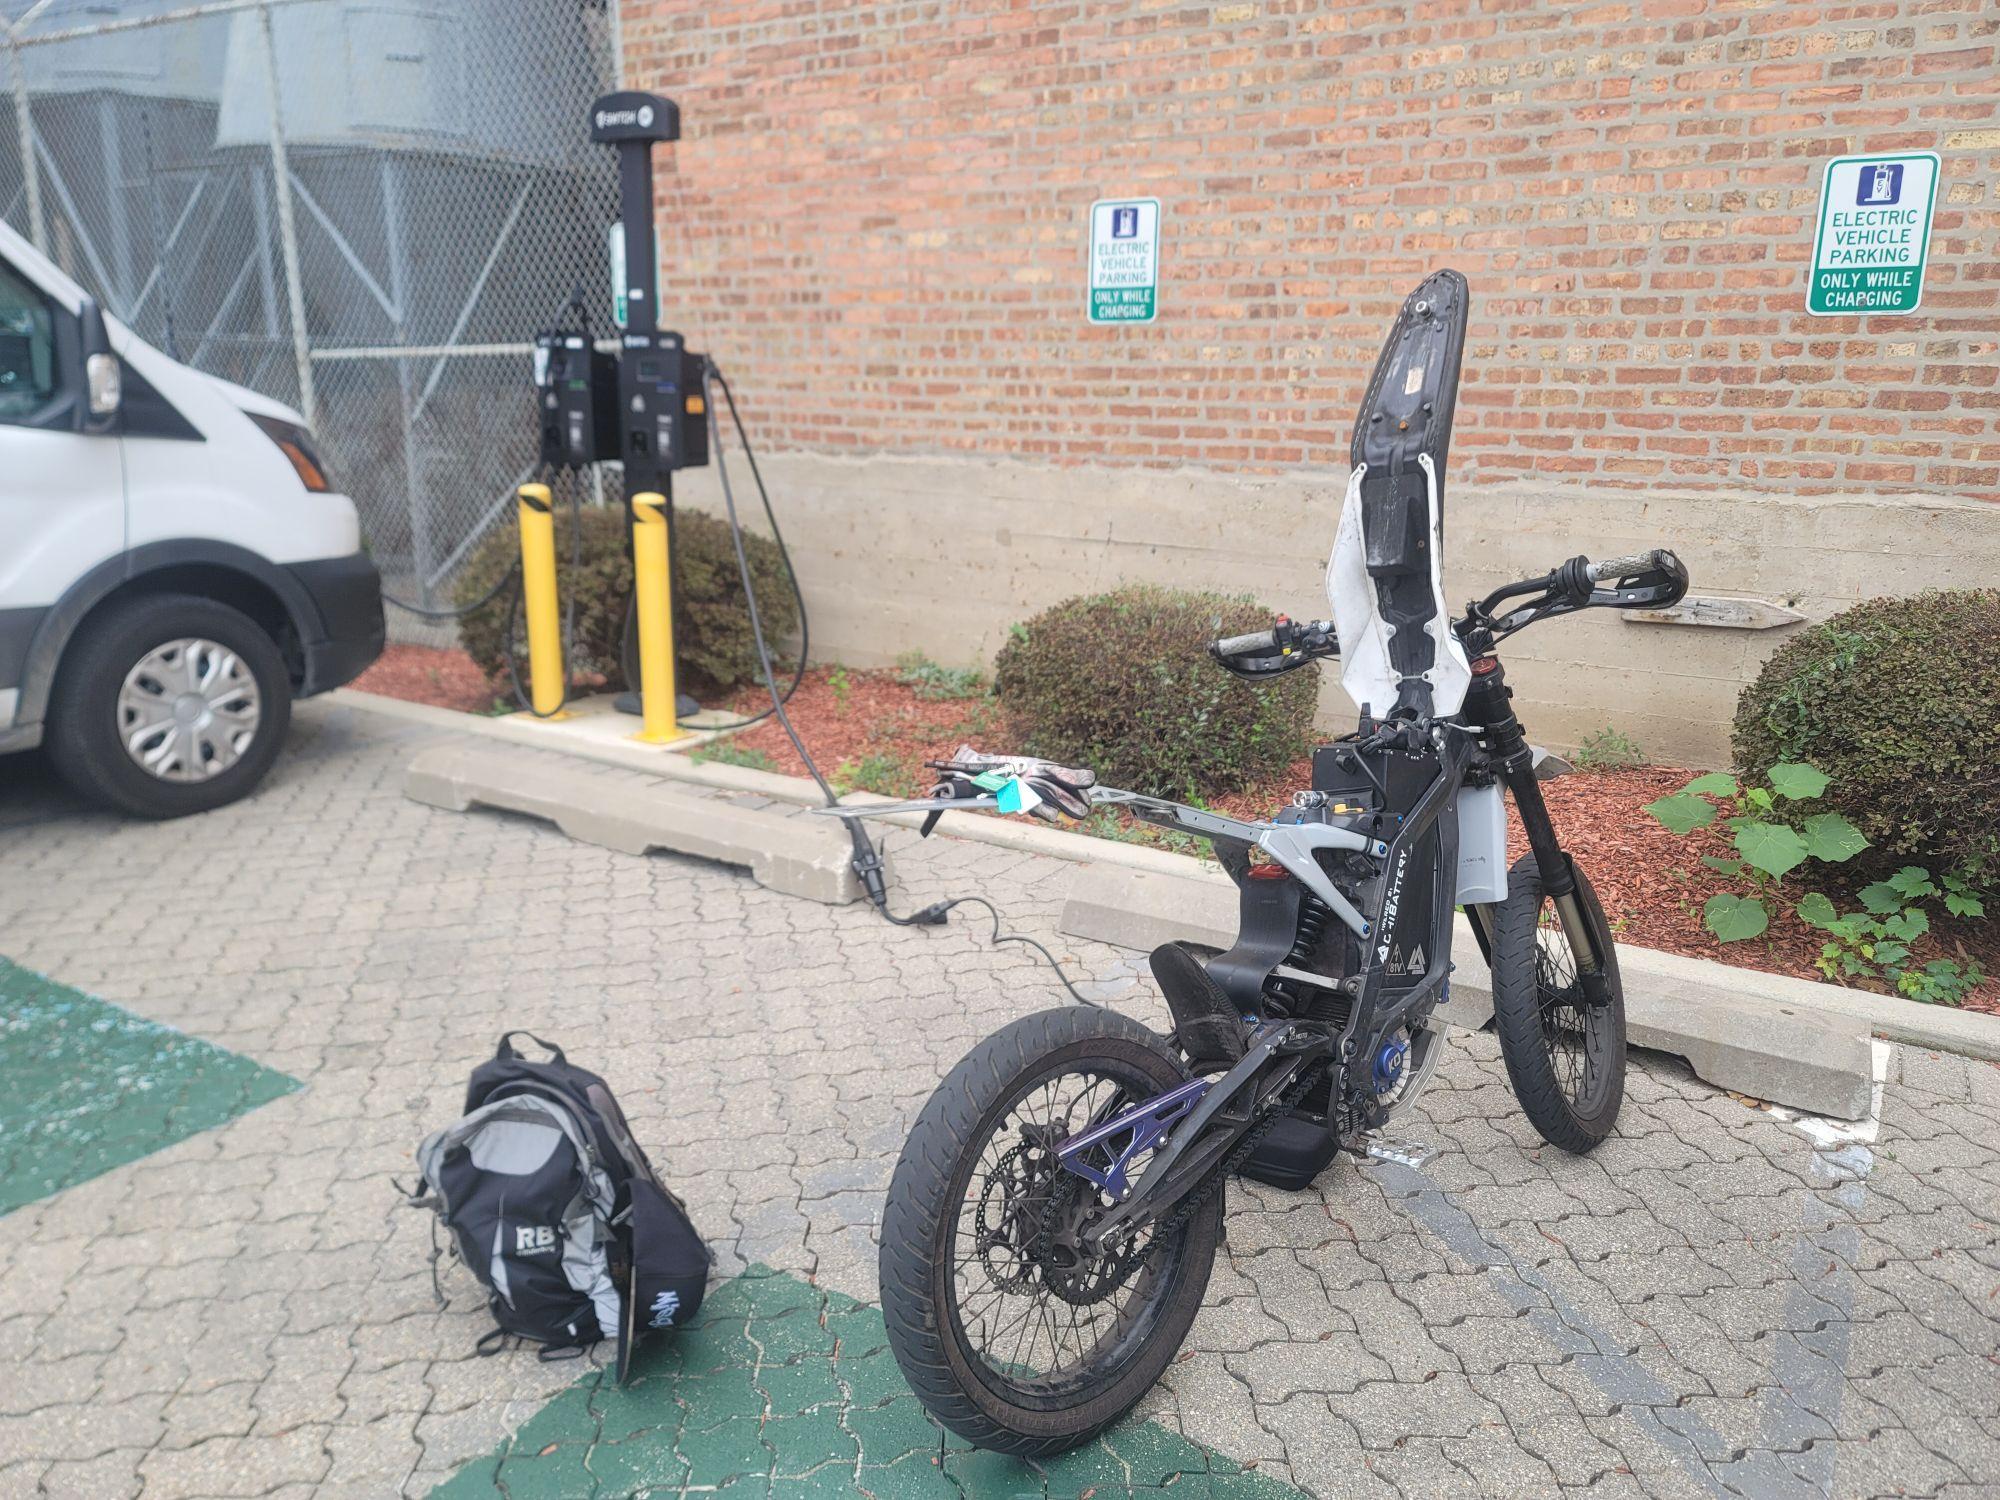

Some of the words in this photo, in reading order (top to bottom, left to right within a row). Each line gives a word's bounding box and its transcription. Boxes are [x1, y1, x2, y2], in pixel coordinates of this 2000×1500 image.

[1832, 210, 1918, 228] ELECTRIC
[1835, 228, 1912, 245] VEHICLE
[1098, 241, 1149, 256] ELECTRIC
[1830, 247, 1910, 265] PARKING
[1100, 257, 1146, 270] VEHICLE
[1099, 272, 1147, 284] PARKING
[1820, 272, 1862, 289] ONLY
[1866, 271, 1914, 288] WHILE
[1094, 290, 1119, 305] ONLY
[1122, 289, 1151, 303] WHILE
[1825, 290, 1903, 307] CHARGING
[1099, 303, 1147, 318] CHARGING
